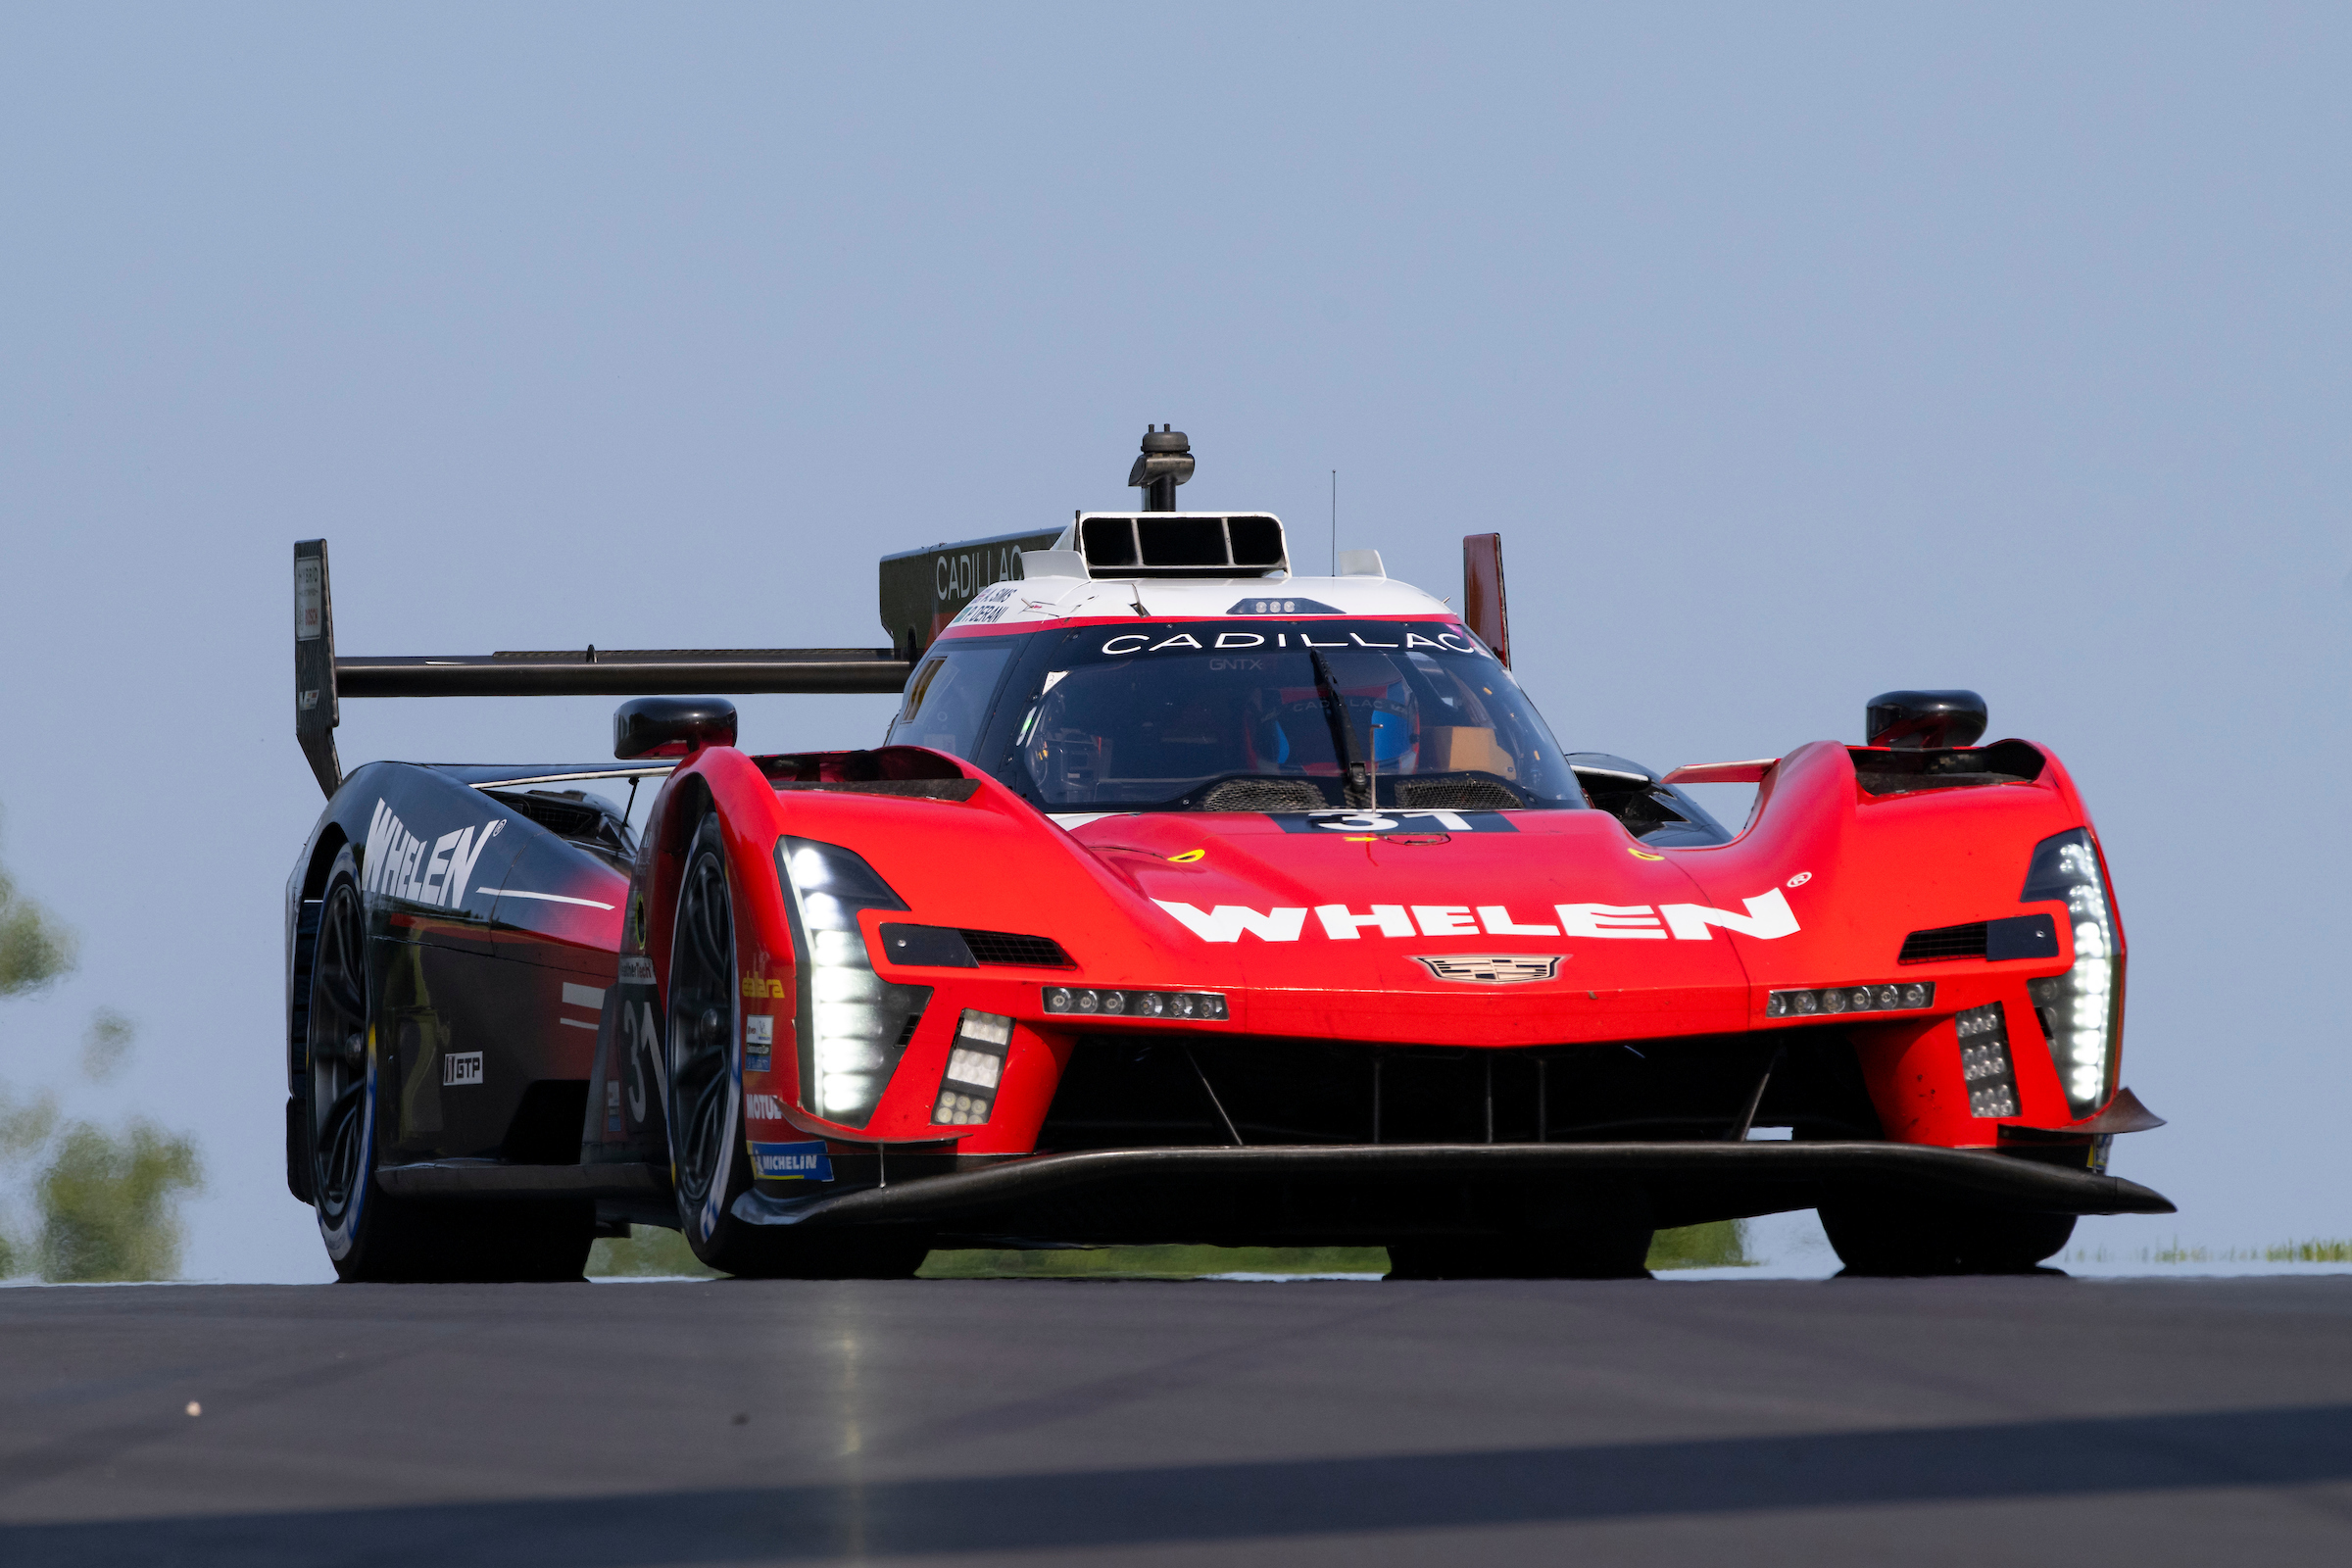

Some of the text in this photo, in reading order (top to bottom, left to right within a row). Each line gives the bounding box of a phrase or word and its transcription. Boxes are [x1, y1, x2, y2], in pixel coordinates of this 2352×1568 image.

[936, 545, 1023, 601] CADILLAC
[1102, 633, 1474, 655] CADILLAC
[1209, 658, 1262, 671] GNTX
[1292, 698, 1384, 712] CADLAC
[1308, 811, 1473, 831] 31
[457, 1057, 480, 1078] GTP
[623, 1000, 668, 1123] 31
[746, 1094, 782, 1119] MOTUL
[762, 1154, 817, 1170] MICHELIN
